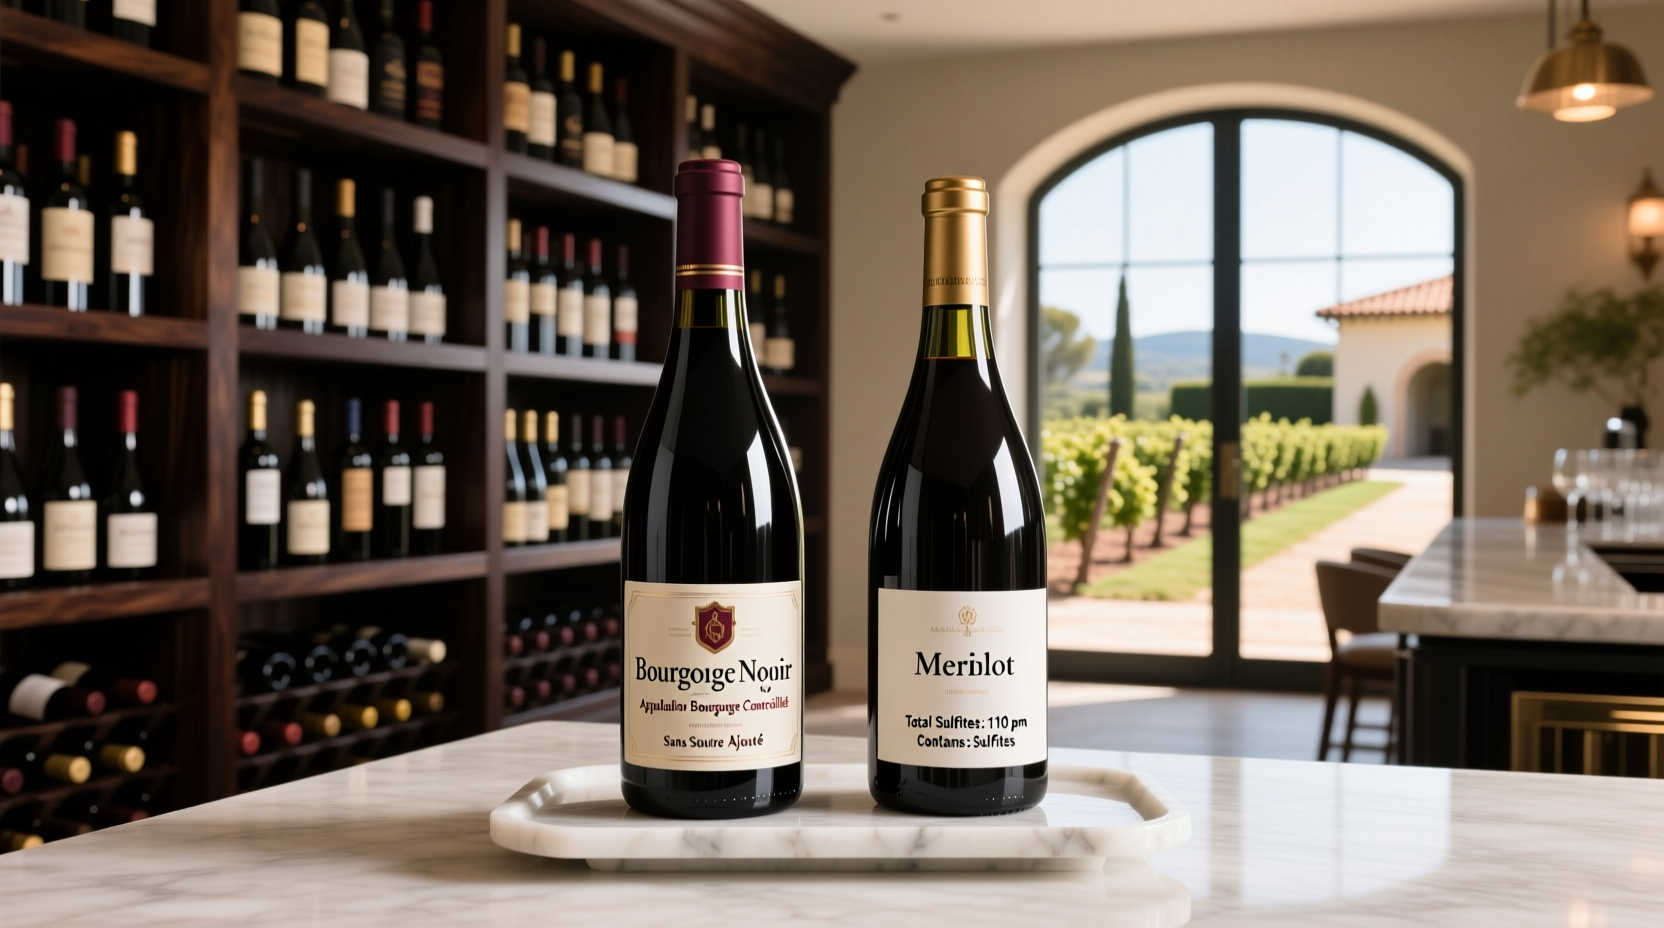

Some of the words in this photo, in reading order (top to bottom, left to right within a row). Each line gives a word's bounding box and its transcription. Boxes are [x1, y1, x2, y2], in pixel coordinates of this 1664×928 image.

[905, 714, 932, 728] Total
[988, 715, 1009, 729] 110
[1011, 717, 1028, 732] pm
[663, 734, 687, 748] Sans
[973, 734, 1016, 748] Sulfites
